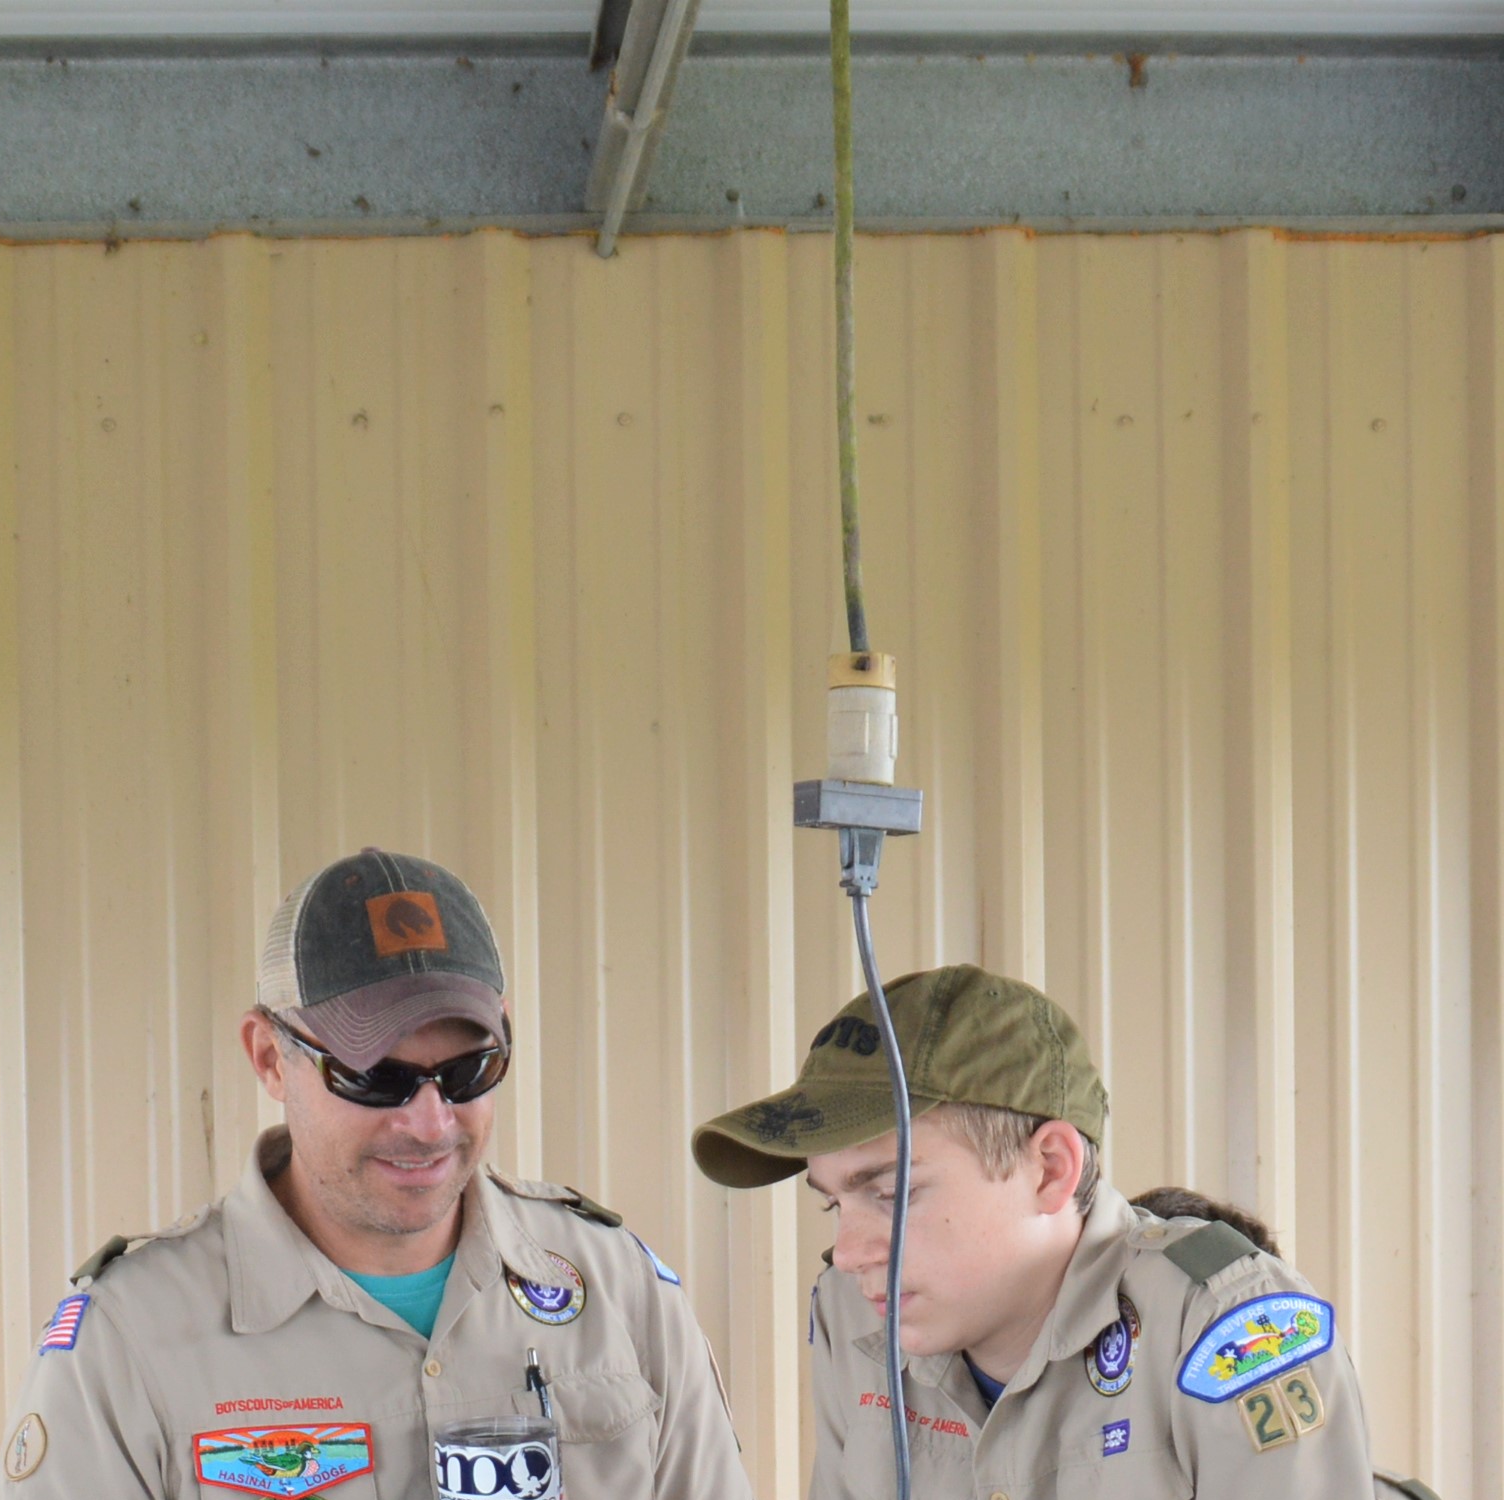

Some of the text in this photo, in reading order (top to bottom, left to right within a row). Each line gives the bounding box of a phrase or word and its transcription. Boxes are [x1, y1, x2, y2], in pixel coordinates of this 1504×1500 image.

[1187, 1299, 1324, 1380] THREE RIVERS COUNCIL
[215, 1401, 239, 1415] BOY
[238, 1398, 283, 1412] SCOUTS
[293, 1396, 344, 1411] AMERICA
[1248, 1379, 1318, 1444] 23
[218, 1463, 348, 1490] HASINAI LODGE
